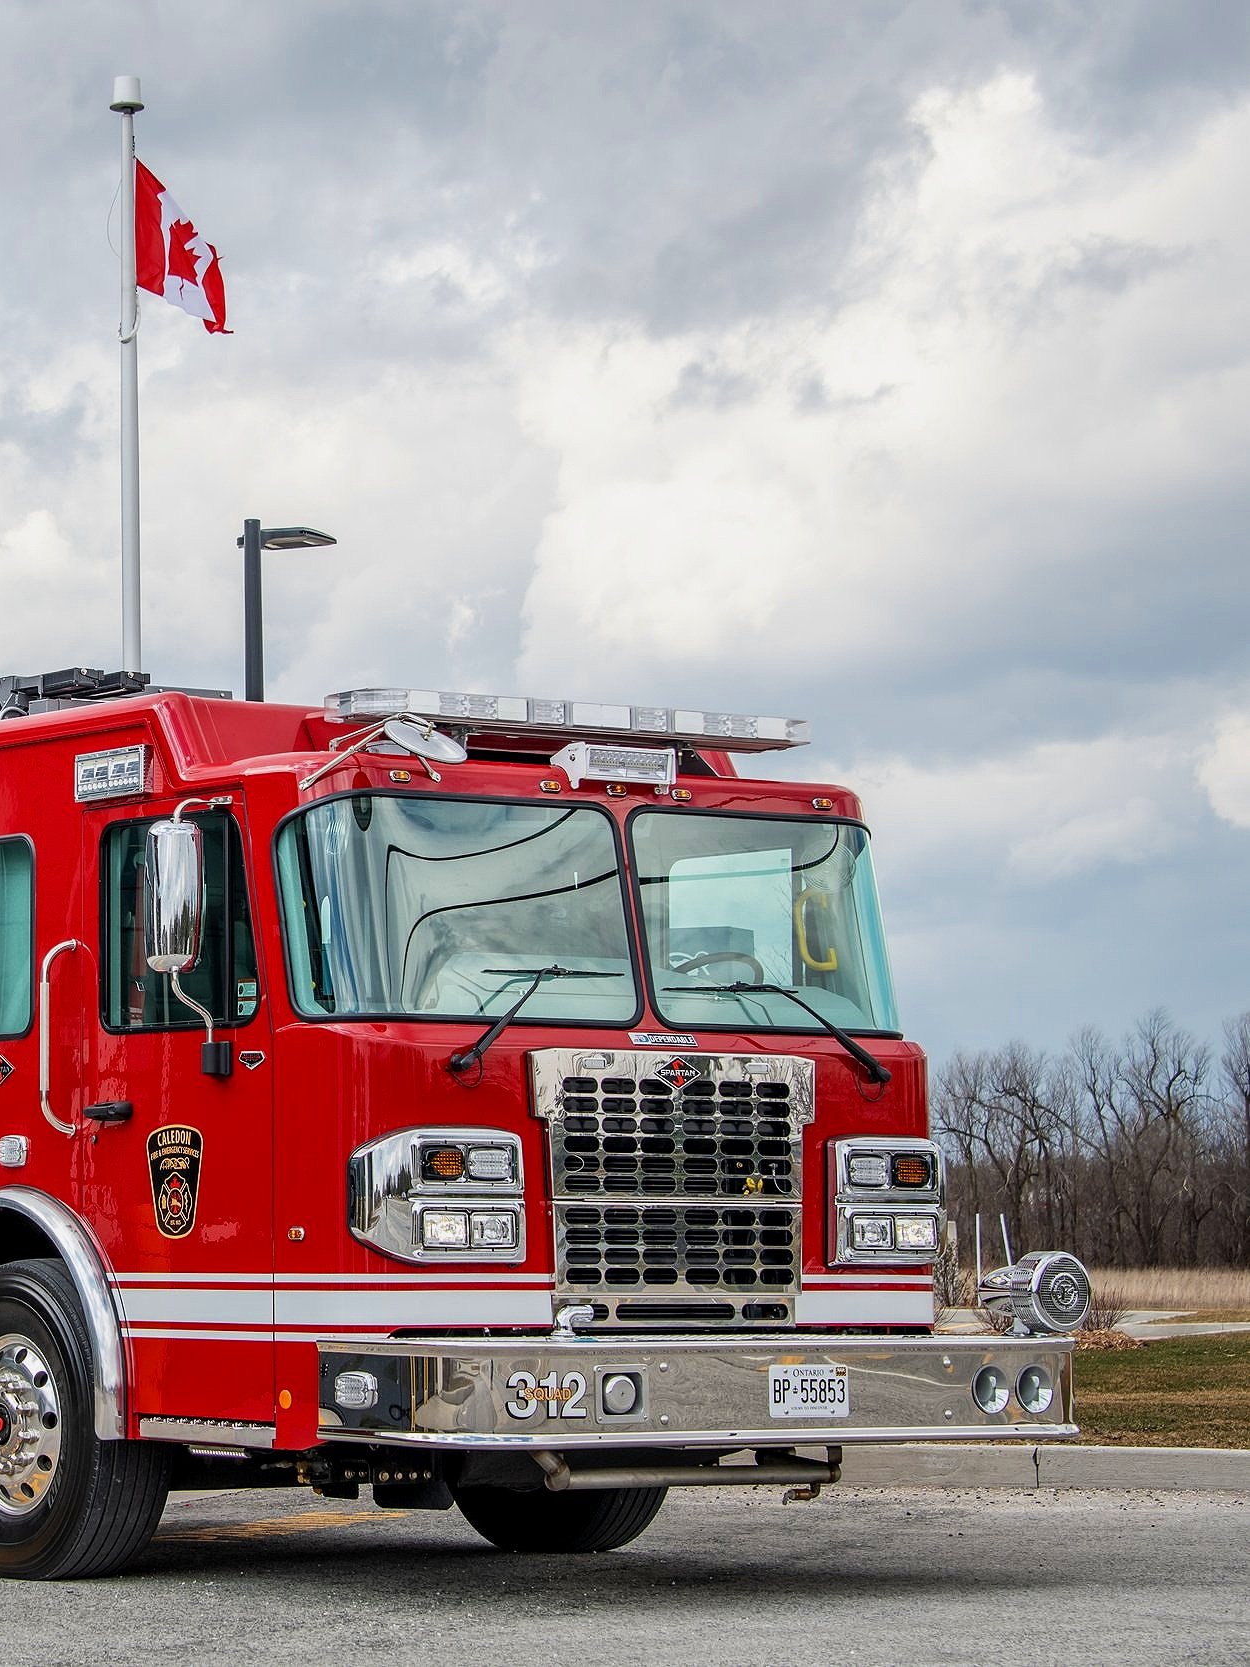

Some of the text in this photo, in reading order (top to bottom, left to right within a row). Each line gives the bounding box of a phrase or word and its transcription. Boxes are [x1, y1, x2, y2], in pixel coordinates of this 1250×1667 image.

[648, 1034, 695, 1044] DEPENDABLE
[157, 1130, 191, 1146] CALEDON
[792, 1368, 825, 1377] ONTARIO
[506, 1370, 588, 1419] 312
[524, 1387, 572, 1401] SQUAD
[800, 1379, 846, 1404] 55853
